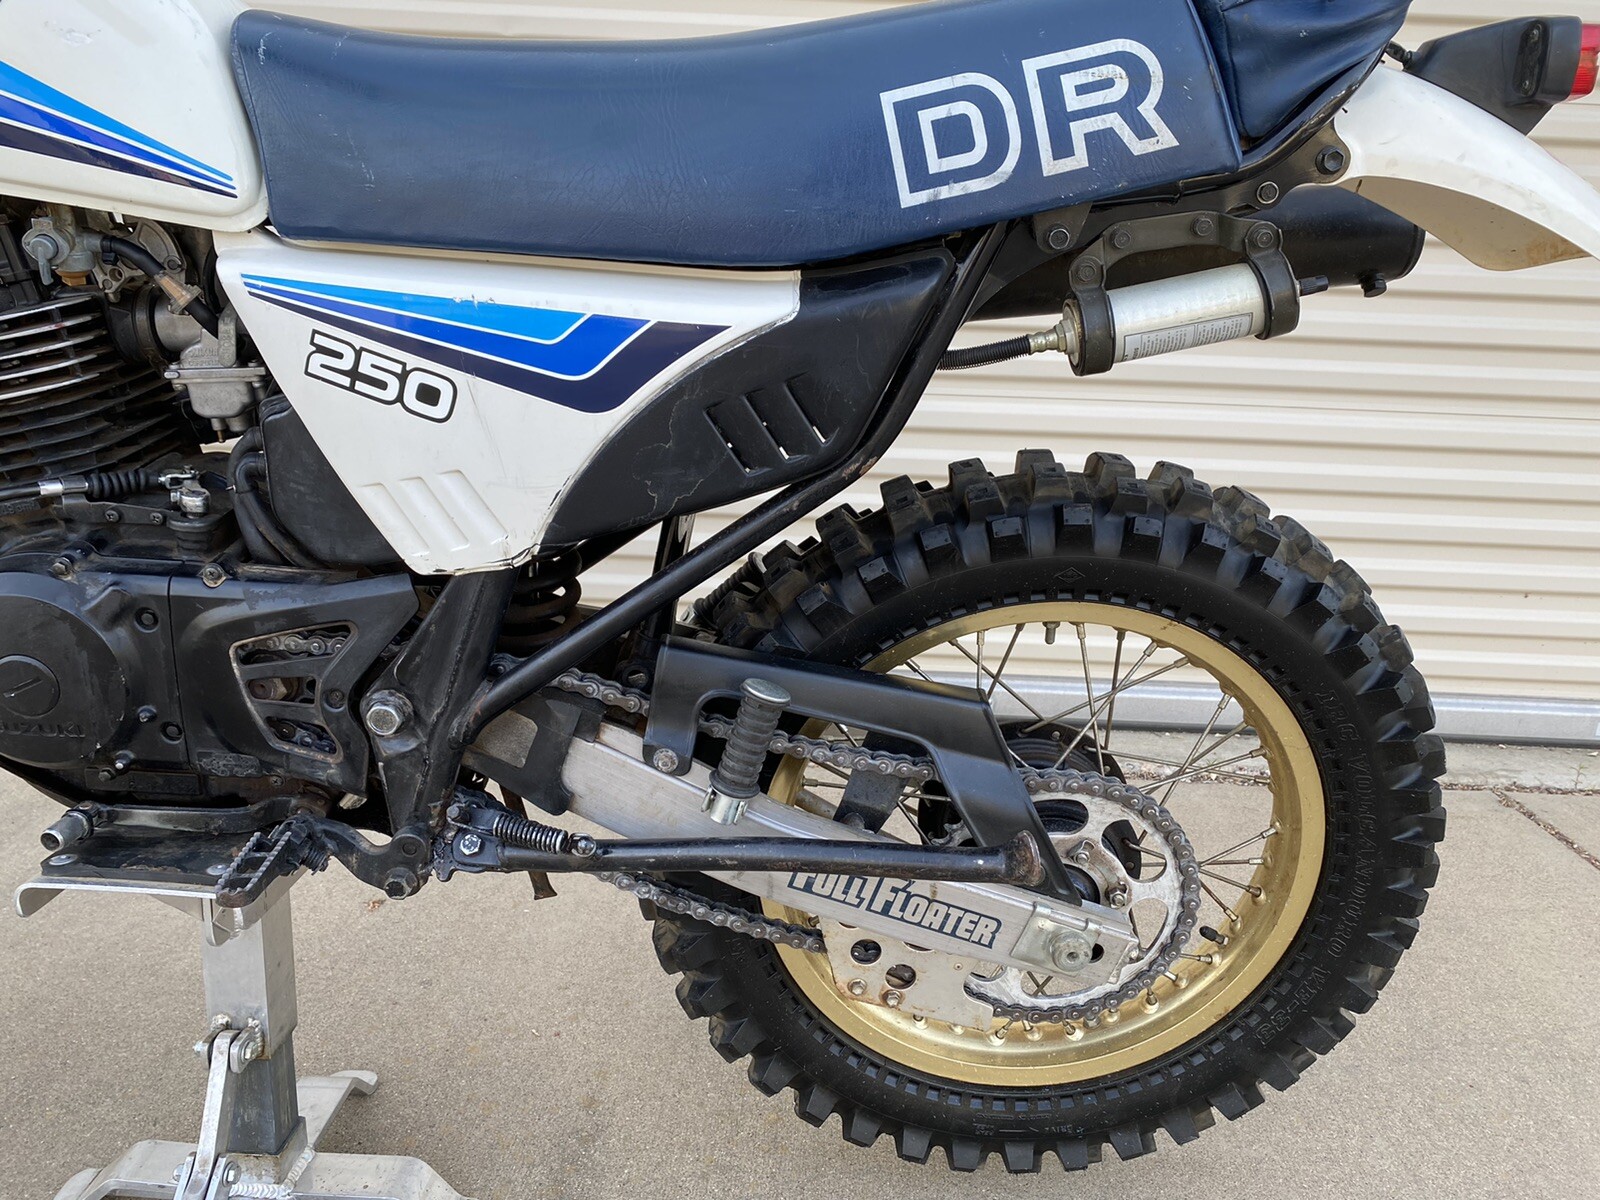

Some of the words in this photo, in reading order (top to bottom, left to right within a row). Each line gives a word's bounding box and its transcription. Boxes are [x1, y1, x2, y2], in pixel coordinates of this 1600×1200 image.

[880, 38, 1180, 209] DR
[304, 328, 458, 424] 250
[0, 721, 86, 738] UZUKI
[866, 876, 1003, 949] FLOATER
